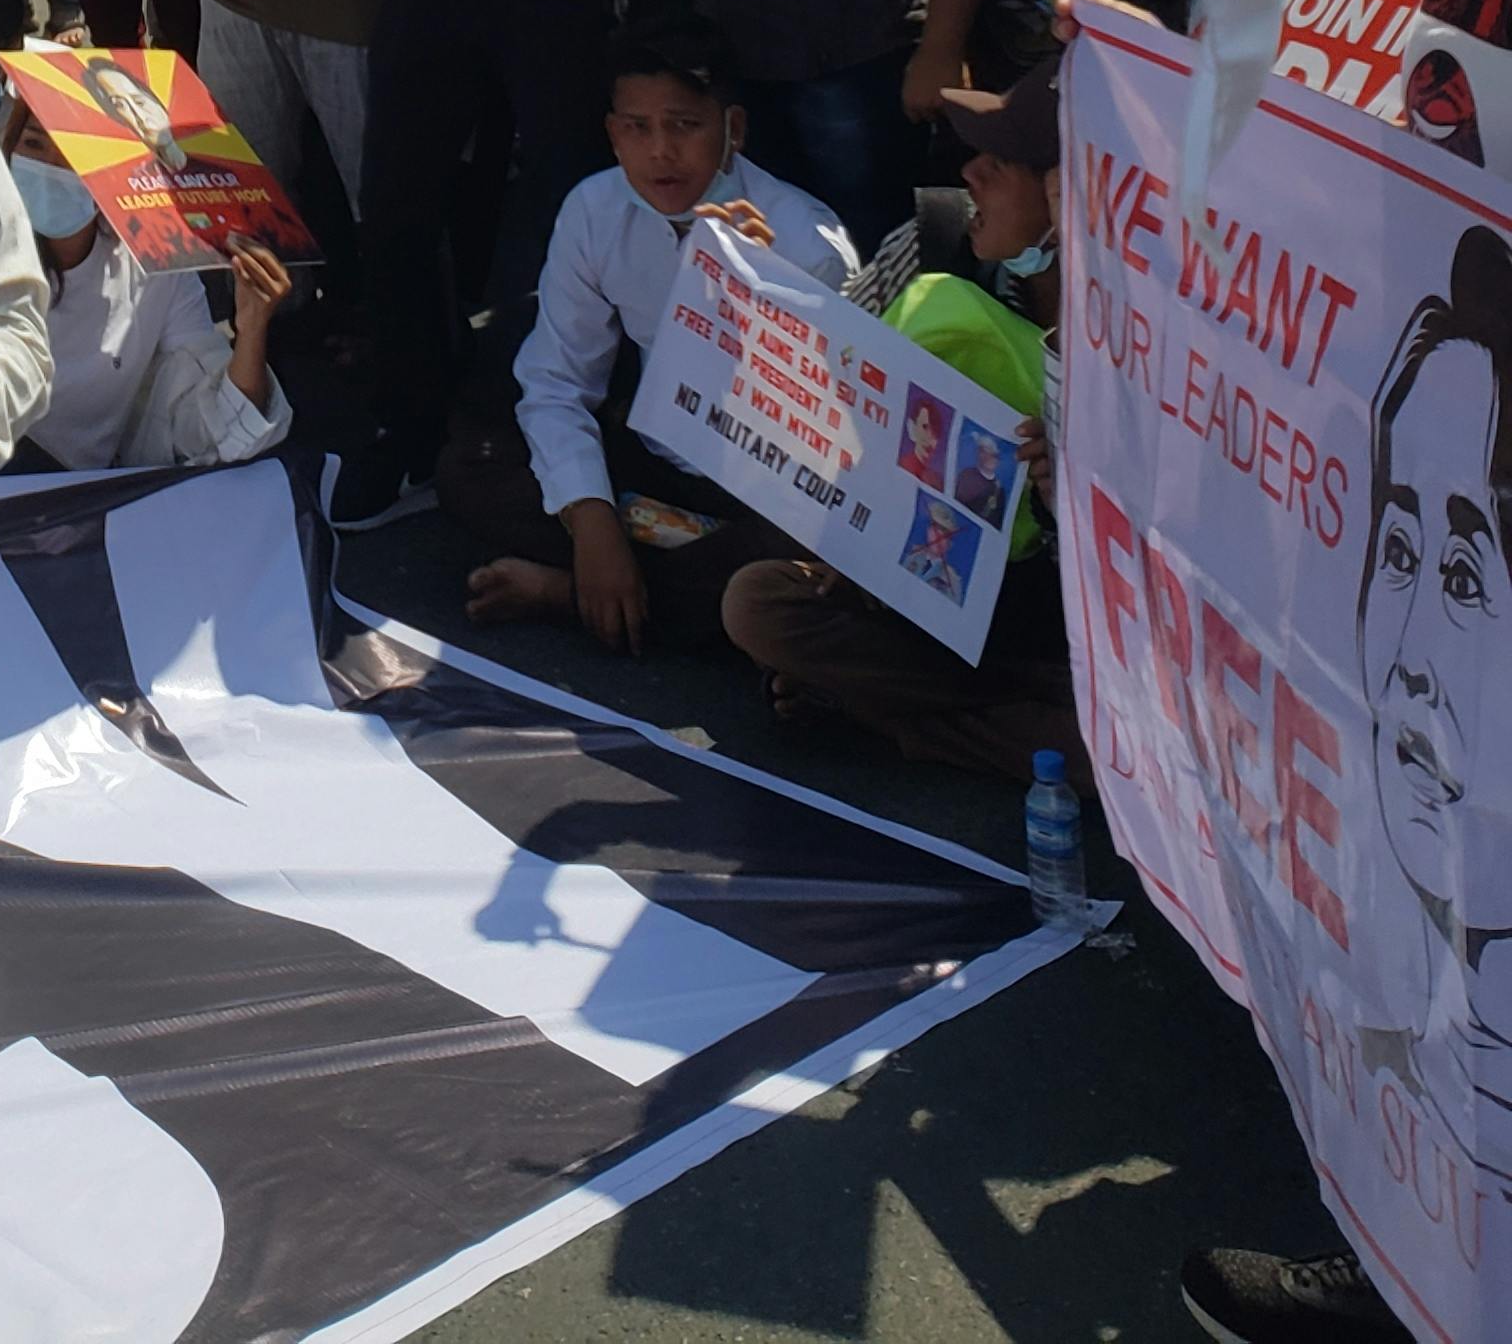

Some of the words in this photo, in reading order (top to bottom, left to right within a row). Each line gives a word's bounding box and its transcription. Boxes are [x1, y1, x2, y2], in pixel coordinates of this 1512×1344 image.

[116, 192, 174, 211] LEADER
[176, 190, 232, 205] FUTURE
[234, 188, 272, 203] HOPE
[174, 174, 212, 189] SAVE
[210, 172, 240, 187] OUR
[693, 248, 724, 284] FREE
[726, 274, 752, 306] OUR
[756, 294, 810, 346] LEADER
[1086, 142, 1170, 277] WE
[1177, 207, 1358, 389] WANT
[673, 303, 715, 341] FREE
[718, 329, 744, 362] OUR
[750, 352, 823, 417] PRESIDENT
[718, 298, 752, 335] DAW
[757, 328, 794, 366] AUNG
[799, 355, 830, 390] SAN
[836, 379, 857, 409] SU
[864, 396, 890, 429] KYI
[731, 374, 745, 397] U
[751, 385, 783, 424] WIN
[786, 411, 834, 459] MYINT
[1086, 277, 1152, 395] OUR
[1159, 332, 1349, 550] LEADERS
[674, 382, 703, 417] NO
[705, 403, 791, 476] MILITARY
[792, 464, 847, 511] COUP
[1090, 480, 1352, 955] FREE
